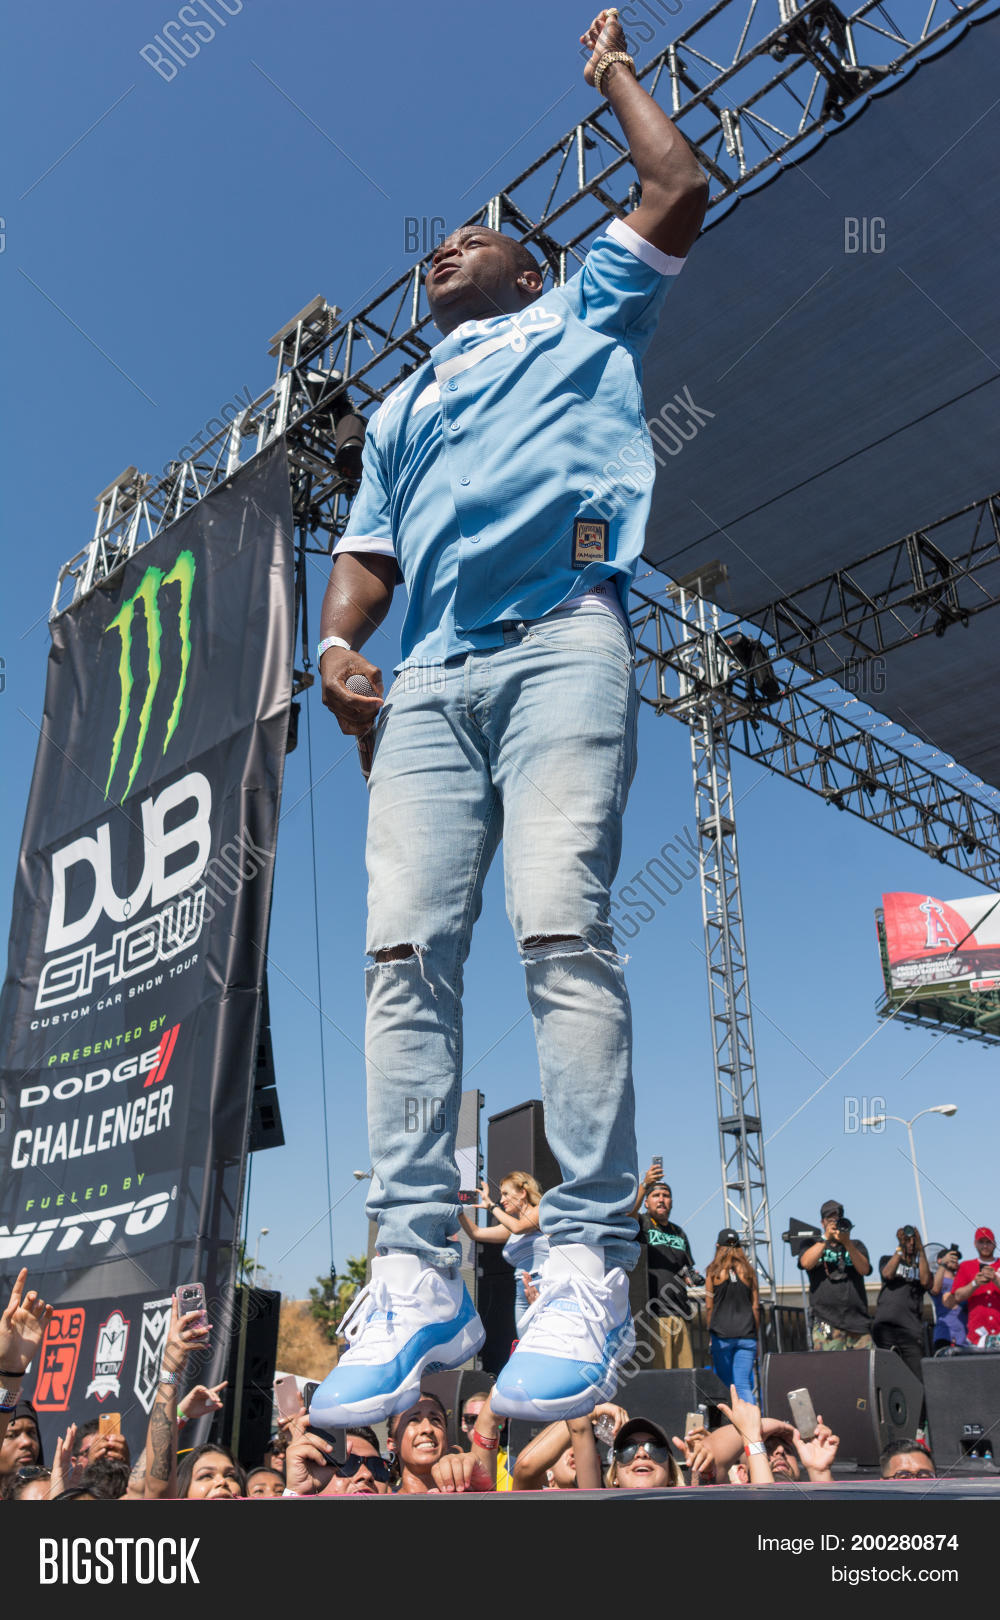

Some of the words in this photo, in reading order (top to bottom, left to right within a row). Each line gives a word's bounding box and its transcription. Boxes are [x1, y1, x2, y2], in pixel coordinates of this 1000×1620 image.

[44, 771, 212, 954] DUB
[34, 885, 207, 1011] SHOW
[30, 1006, 90, 1031] CUSTOM
[97, 993, 122, 1010] CAR
[128, 976, 164, 998] SHOW
[169, 954, 199, 977] TOUR
[48, 1027, 142, 1066] PRESENTED
[149, 1014, 167, 1033] BY
[19, 1045, 162, 1108] DODGE
[11, 1084, 174, 1170] CHALLENGER
[25, 1184, 108, 1211] FUELED
[123, 1173, 145, 1190] BY
[47, 1314, 83, 1341] DUB
